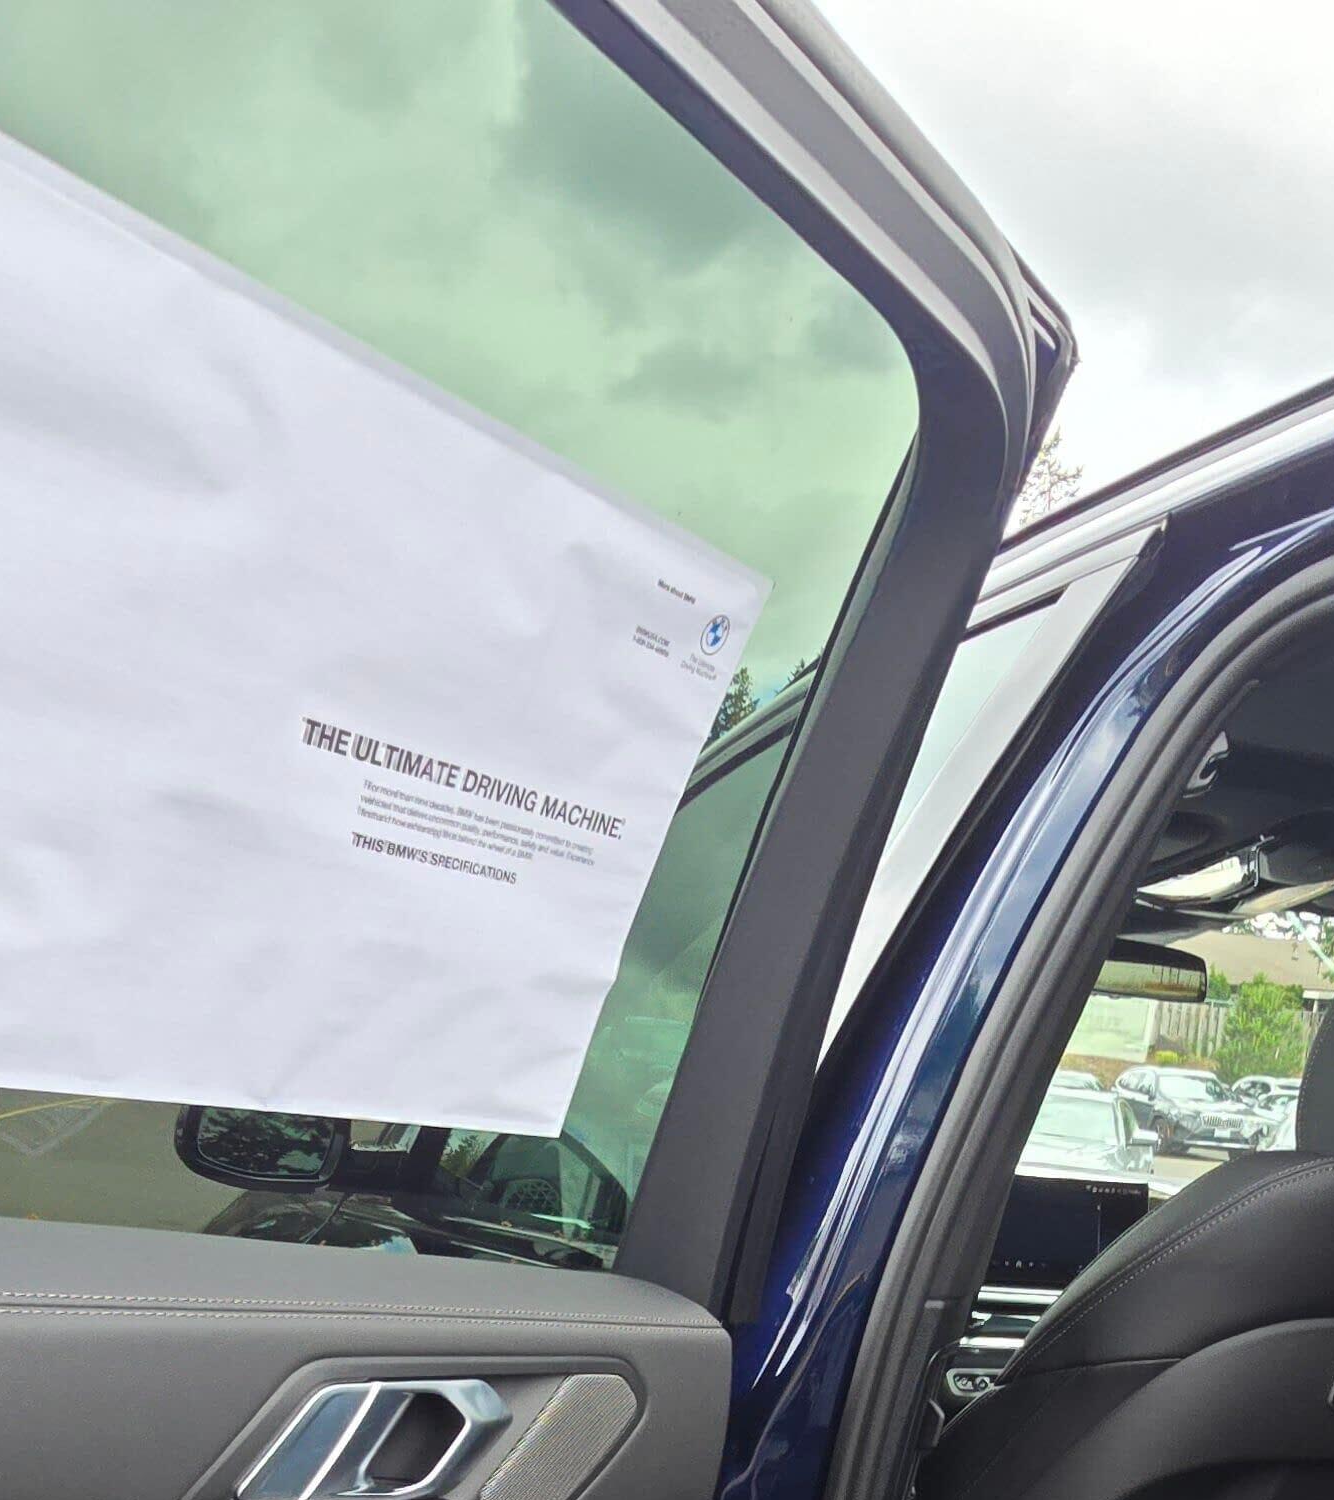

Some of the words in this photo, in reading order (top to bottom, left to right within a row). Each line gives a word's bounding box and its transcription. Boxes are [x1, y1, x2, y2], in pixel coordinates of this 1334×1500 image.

[303, 717, 352, 756] THE
[353, 734, 460, 788] ULTIMATE
[462, 769, 538, 812] DRIVING
[353, 832, 385, 852] THIS
[430, 853, 517, 884] SPECIFICATIONS
